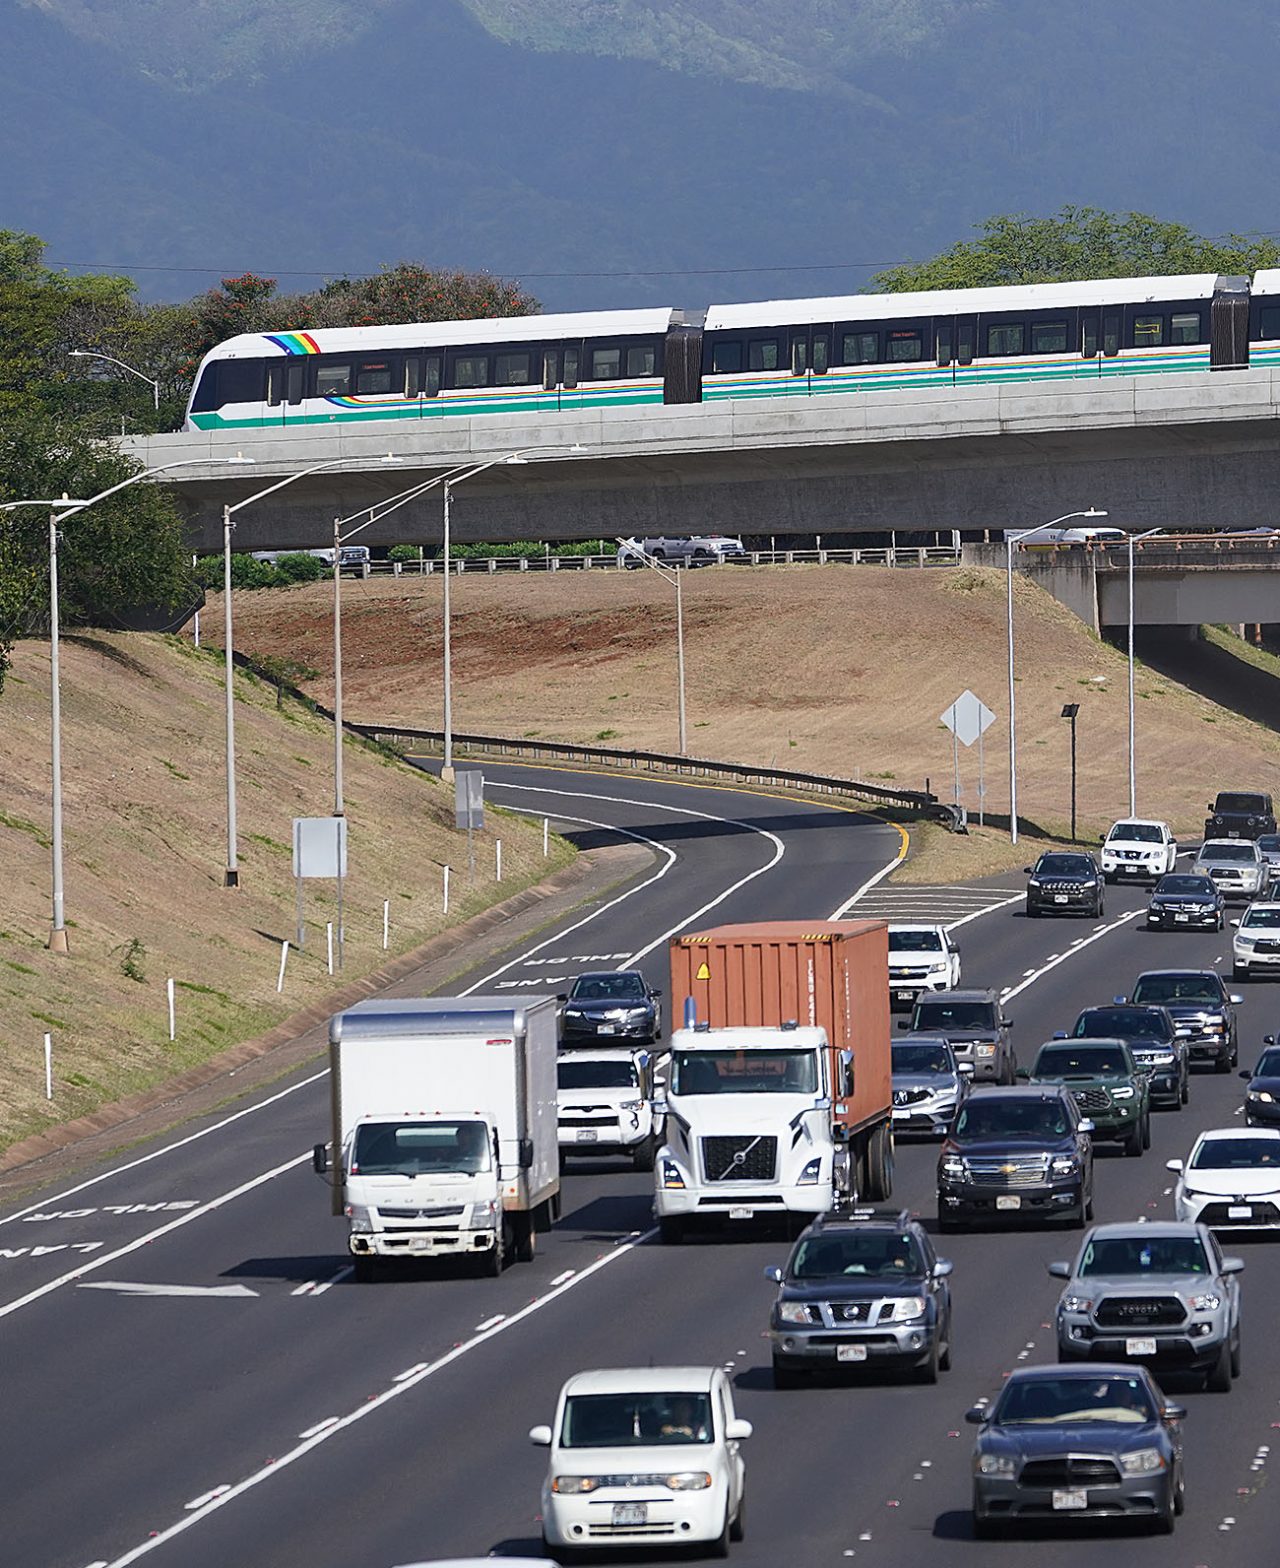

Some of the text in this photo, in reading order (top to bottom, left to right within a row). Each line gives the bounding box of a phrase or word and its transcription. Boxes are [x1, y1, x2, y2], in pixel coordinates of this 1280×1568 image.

[523, 952, 633, 966] SHLDR
[22, 1200, 201, 1223] SHLDR
[1123, 1304, 1158, 1314] TOYOTA
